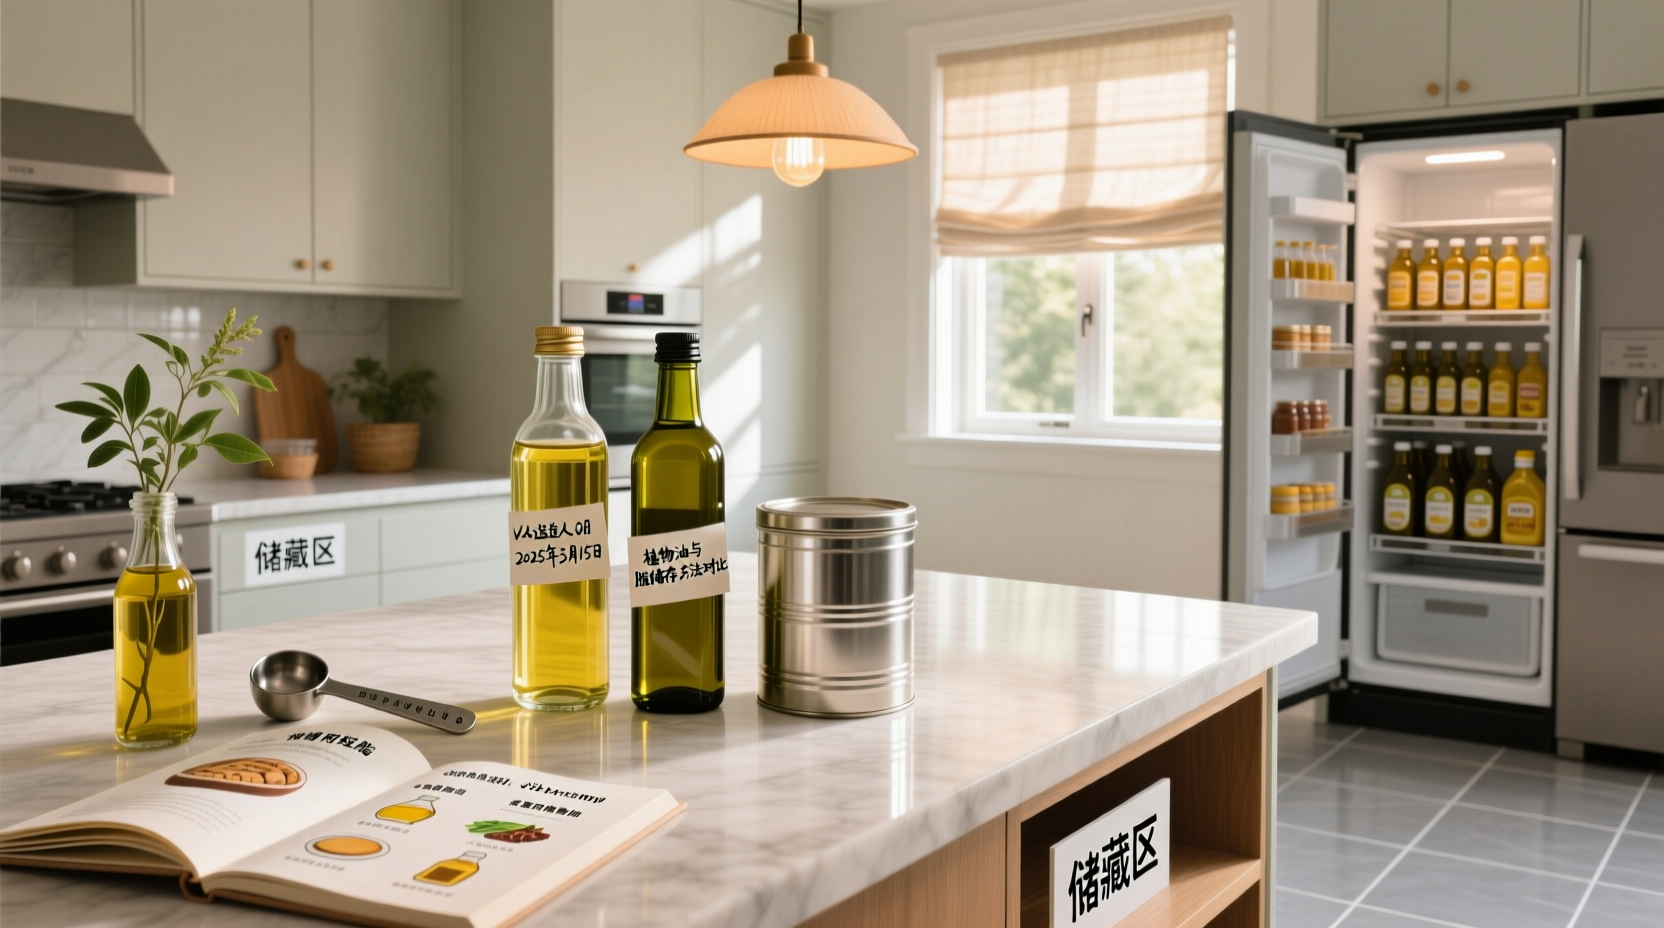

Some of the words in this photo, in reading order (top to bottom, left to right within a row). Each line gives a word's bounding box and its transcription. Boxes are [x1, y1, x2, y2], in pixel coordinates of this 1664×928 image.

[254, 535, 335, 575] 储藏区
[515, 543, 602, 568] 2025年3月15日
[643, 541, 702, 566] 植物油与
[1068, 813, 1158, 923] 储藏区
